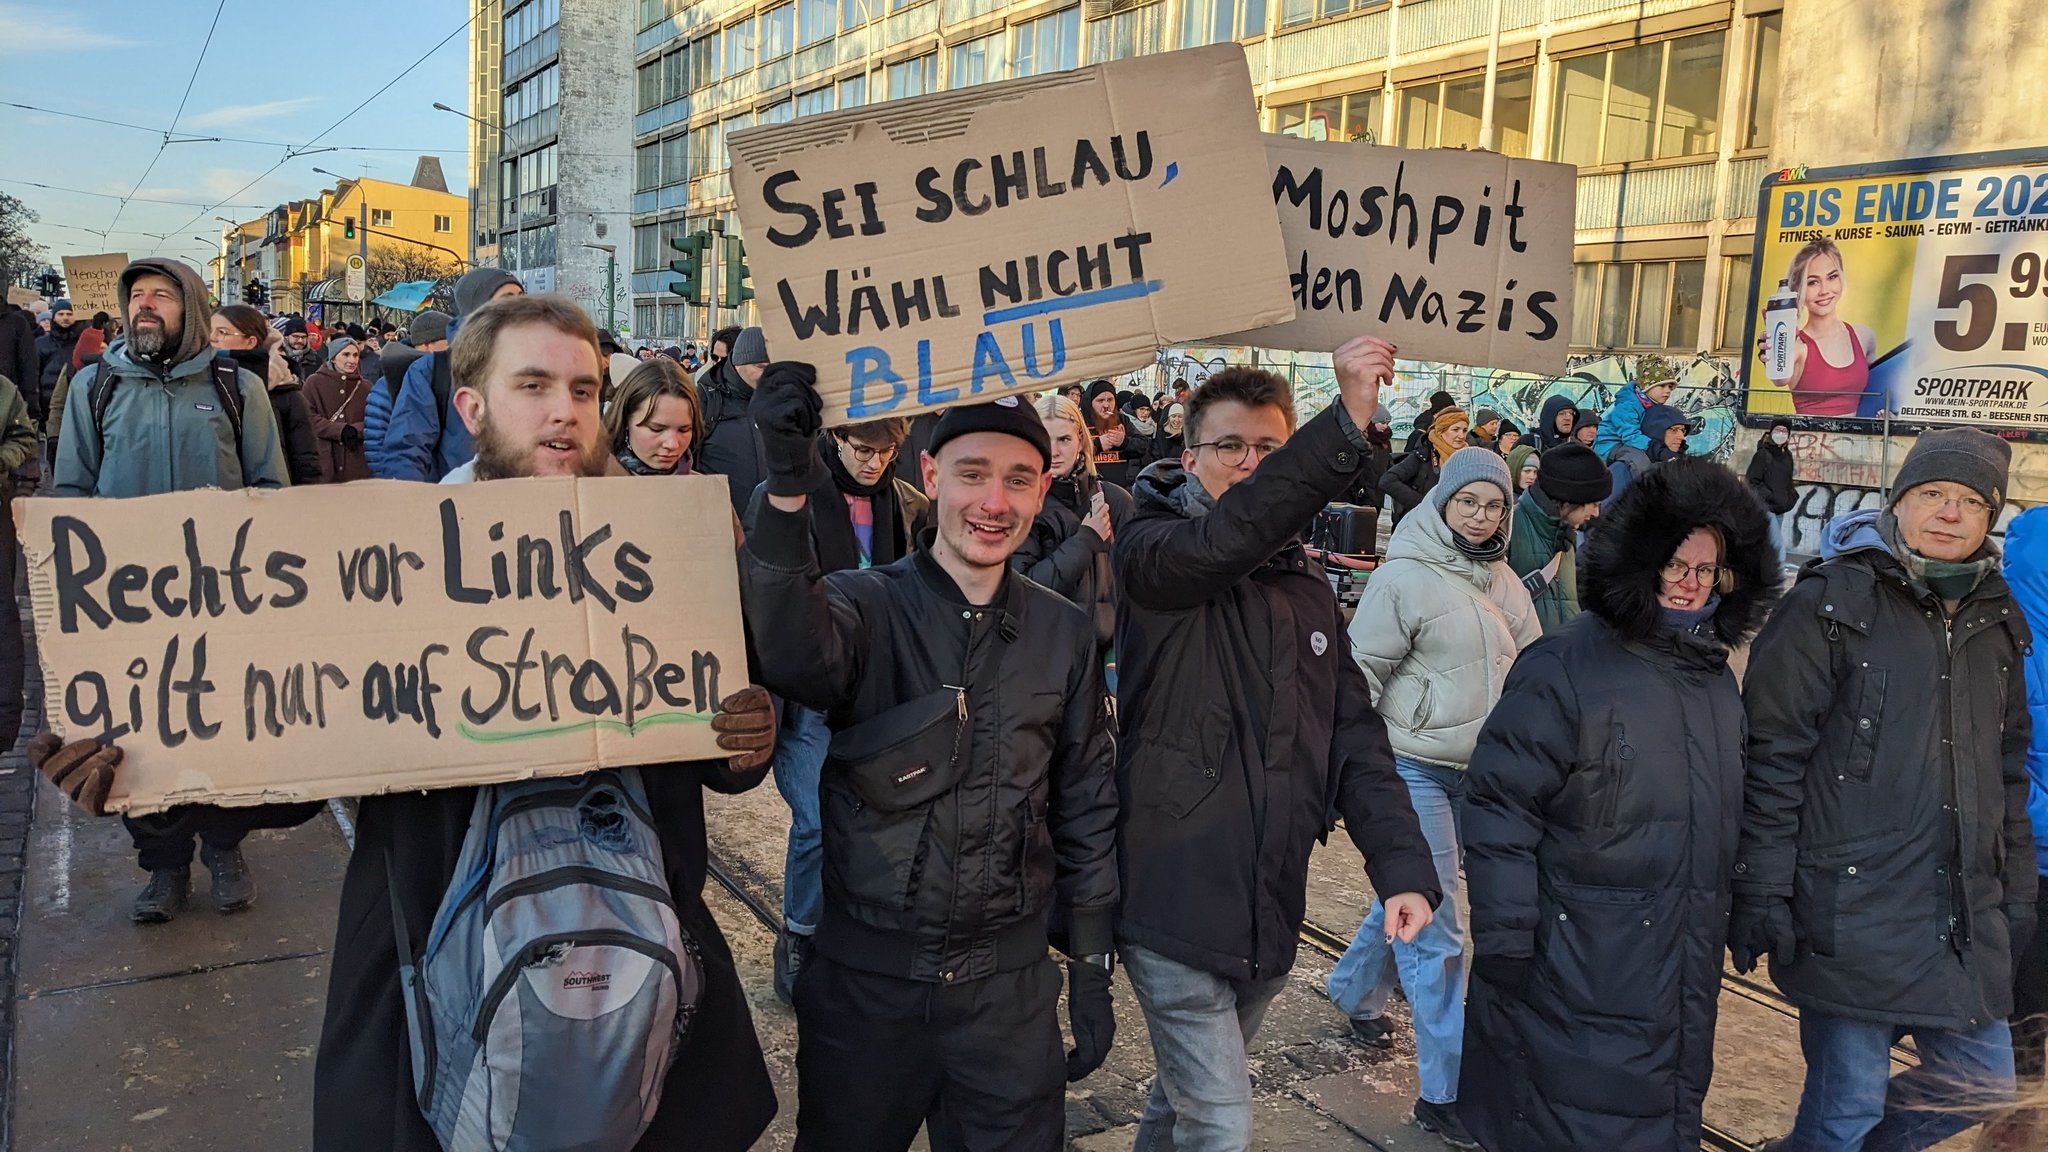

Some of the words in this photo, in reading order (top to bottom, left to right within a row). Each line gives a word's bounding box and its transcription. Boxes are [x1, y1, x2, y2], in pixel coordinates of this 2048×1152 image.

[1778, 164, 1808, 181] awk
[762, 169, 886, 249] SEI
[915, 130, 1179, 224] SCHLAU,
[1780, 187, 1842, 228] BIS
[1854, 178, 1962, 224] ENDE
[1973, 173, 2048, 217] 202
[1272, 160, 1528, 265] Moshpit
[1779, 229, 1823, 243] FITNESS
[1835, 227, 1873, 240] KURSE
[1885, 224, 1925, 238] SAUNA
[1937, 222, 1972, 235] EGYM
[777, 266, 960, 340] WÄHL
[979, 231, 1152, 310] NICHT
[1290, 249, 1362, 314] den
[1378, 275, 1559, 341] Nazis
[2032, 335, 2048, 346] WO
[2034, 322, 2048, 333] EU
[1777, 331, 1785, 372] SPORTPARK
[845, 317, 1066, 420] BLAU
[1914, 377, 2033, 400] SPORTPARK
[1925, 397, 2028, 409] WWW.MEIN-SPORTPARK.DE
[1901, 407, 1951, 417] DELITZSCHER
[1952, 408, 1969, 418] STR.
[1971, 410, 1981, 419] 63
[1989, 411, 2032, 422] BEESENER
[51, 515, 309, 633] Rechts
[338, 542, 425, 606] vor
[439, 497, 654, 614] Links
[65, 632, 223, 749] gilt
[244, 661, 349, 742] nur
[362, 643, 449, 740] auf
[461, 623, 724, 737] Straßen
[897, 766, 928, 783] EASTPAK
[563, 974, 612, 987] SOUTHWEST
